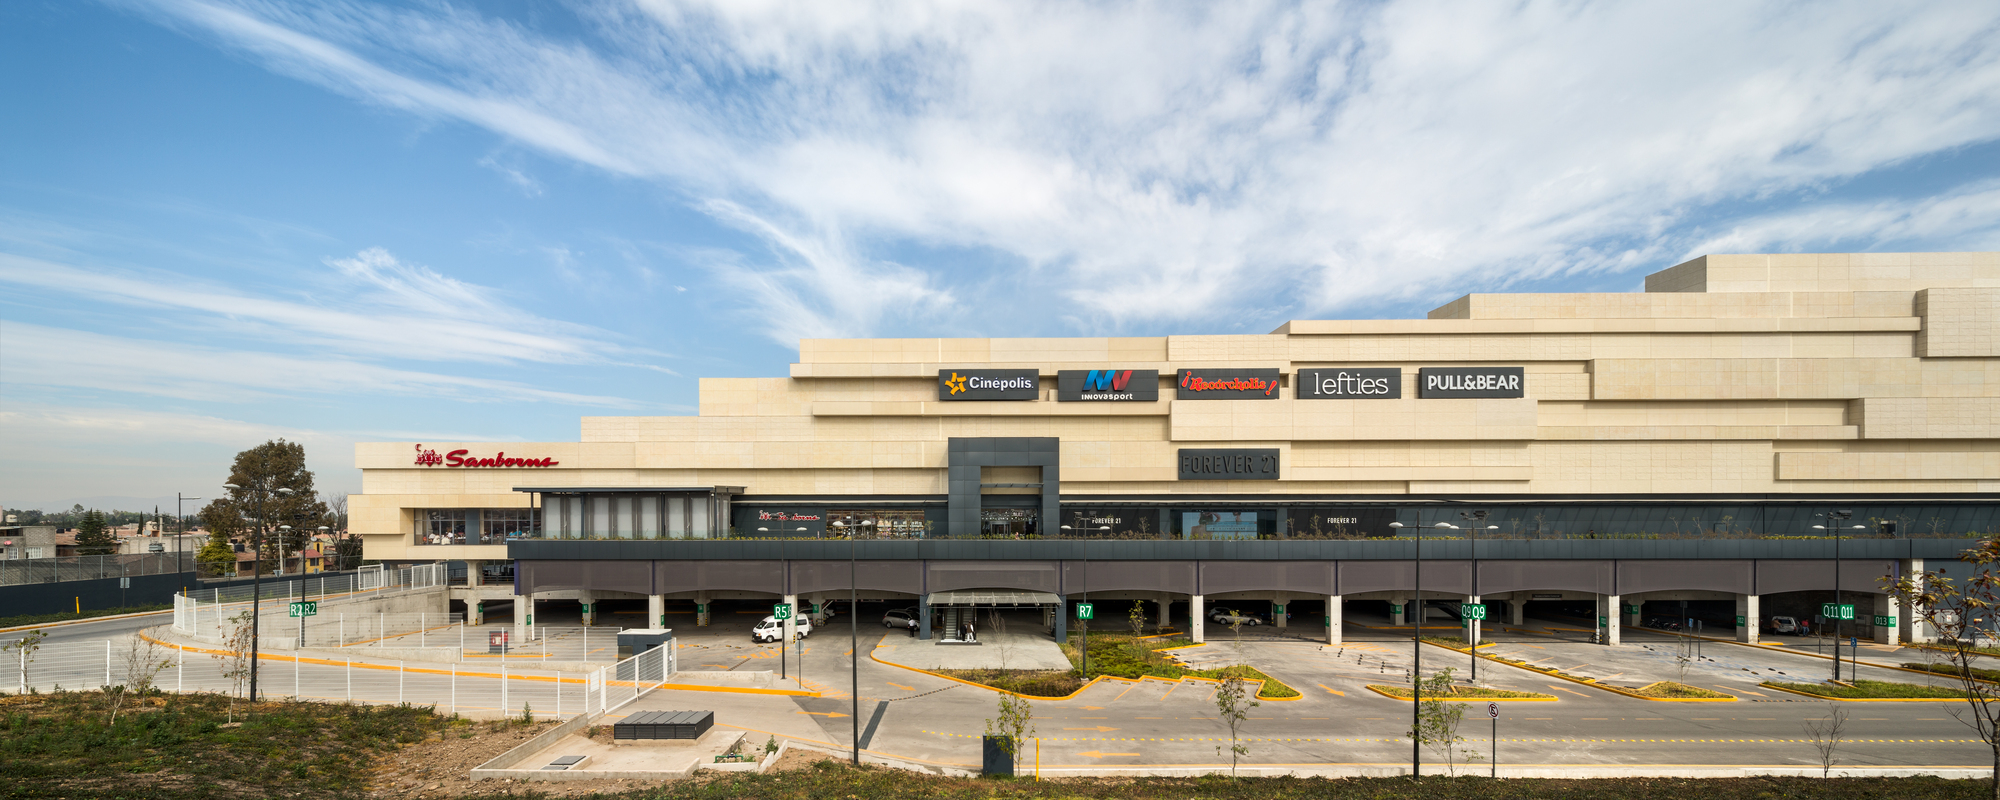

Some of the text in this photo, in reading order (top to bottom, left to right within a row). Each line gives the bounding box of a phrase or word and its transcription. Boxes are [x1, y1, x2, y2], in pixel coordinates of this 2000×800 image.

[1313, 372, 1389, 395] lefties
[1427, 375, 1520, 391] PULL&BEAR
[445, 449, 559, 467] Sanborns
[1181, 455, 1278, 473] FOREVER 21
[290, 604, 303, 616] R2
[305, 603, 316, 615] R2
[775, 606, 787, 618] R5
[1079, 605, 1092, 618] R7
[1472, 606, 1485, 620] Q9
[1823, 605, 1840, 618] Q11
[1841, 606, 1853, 619] Q11
